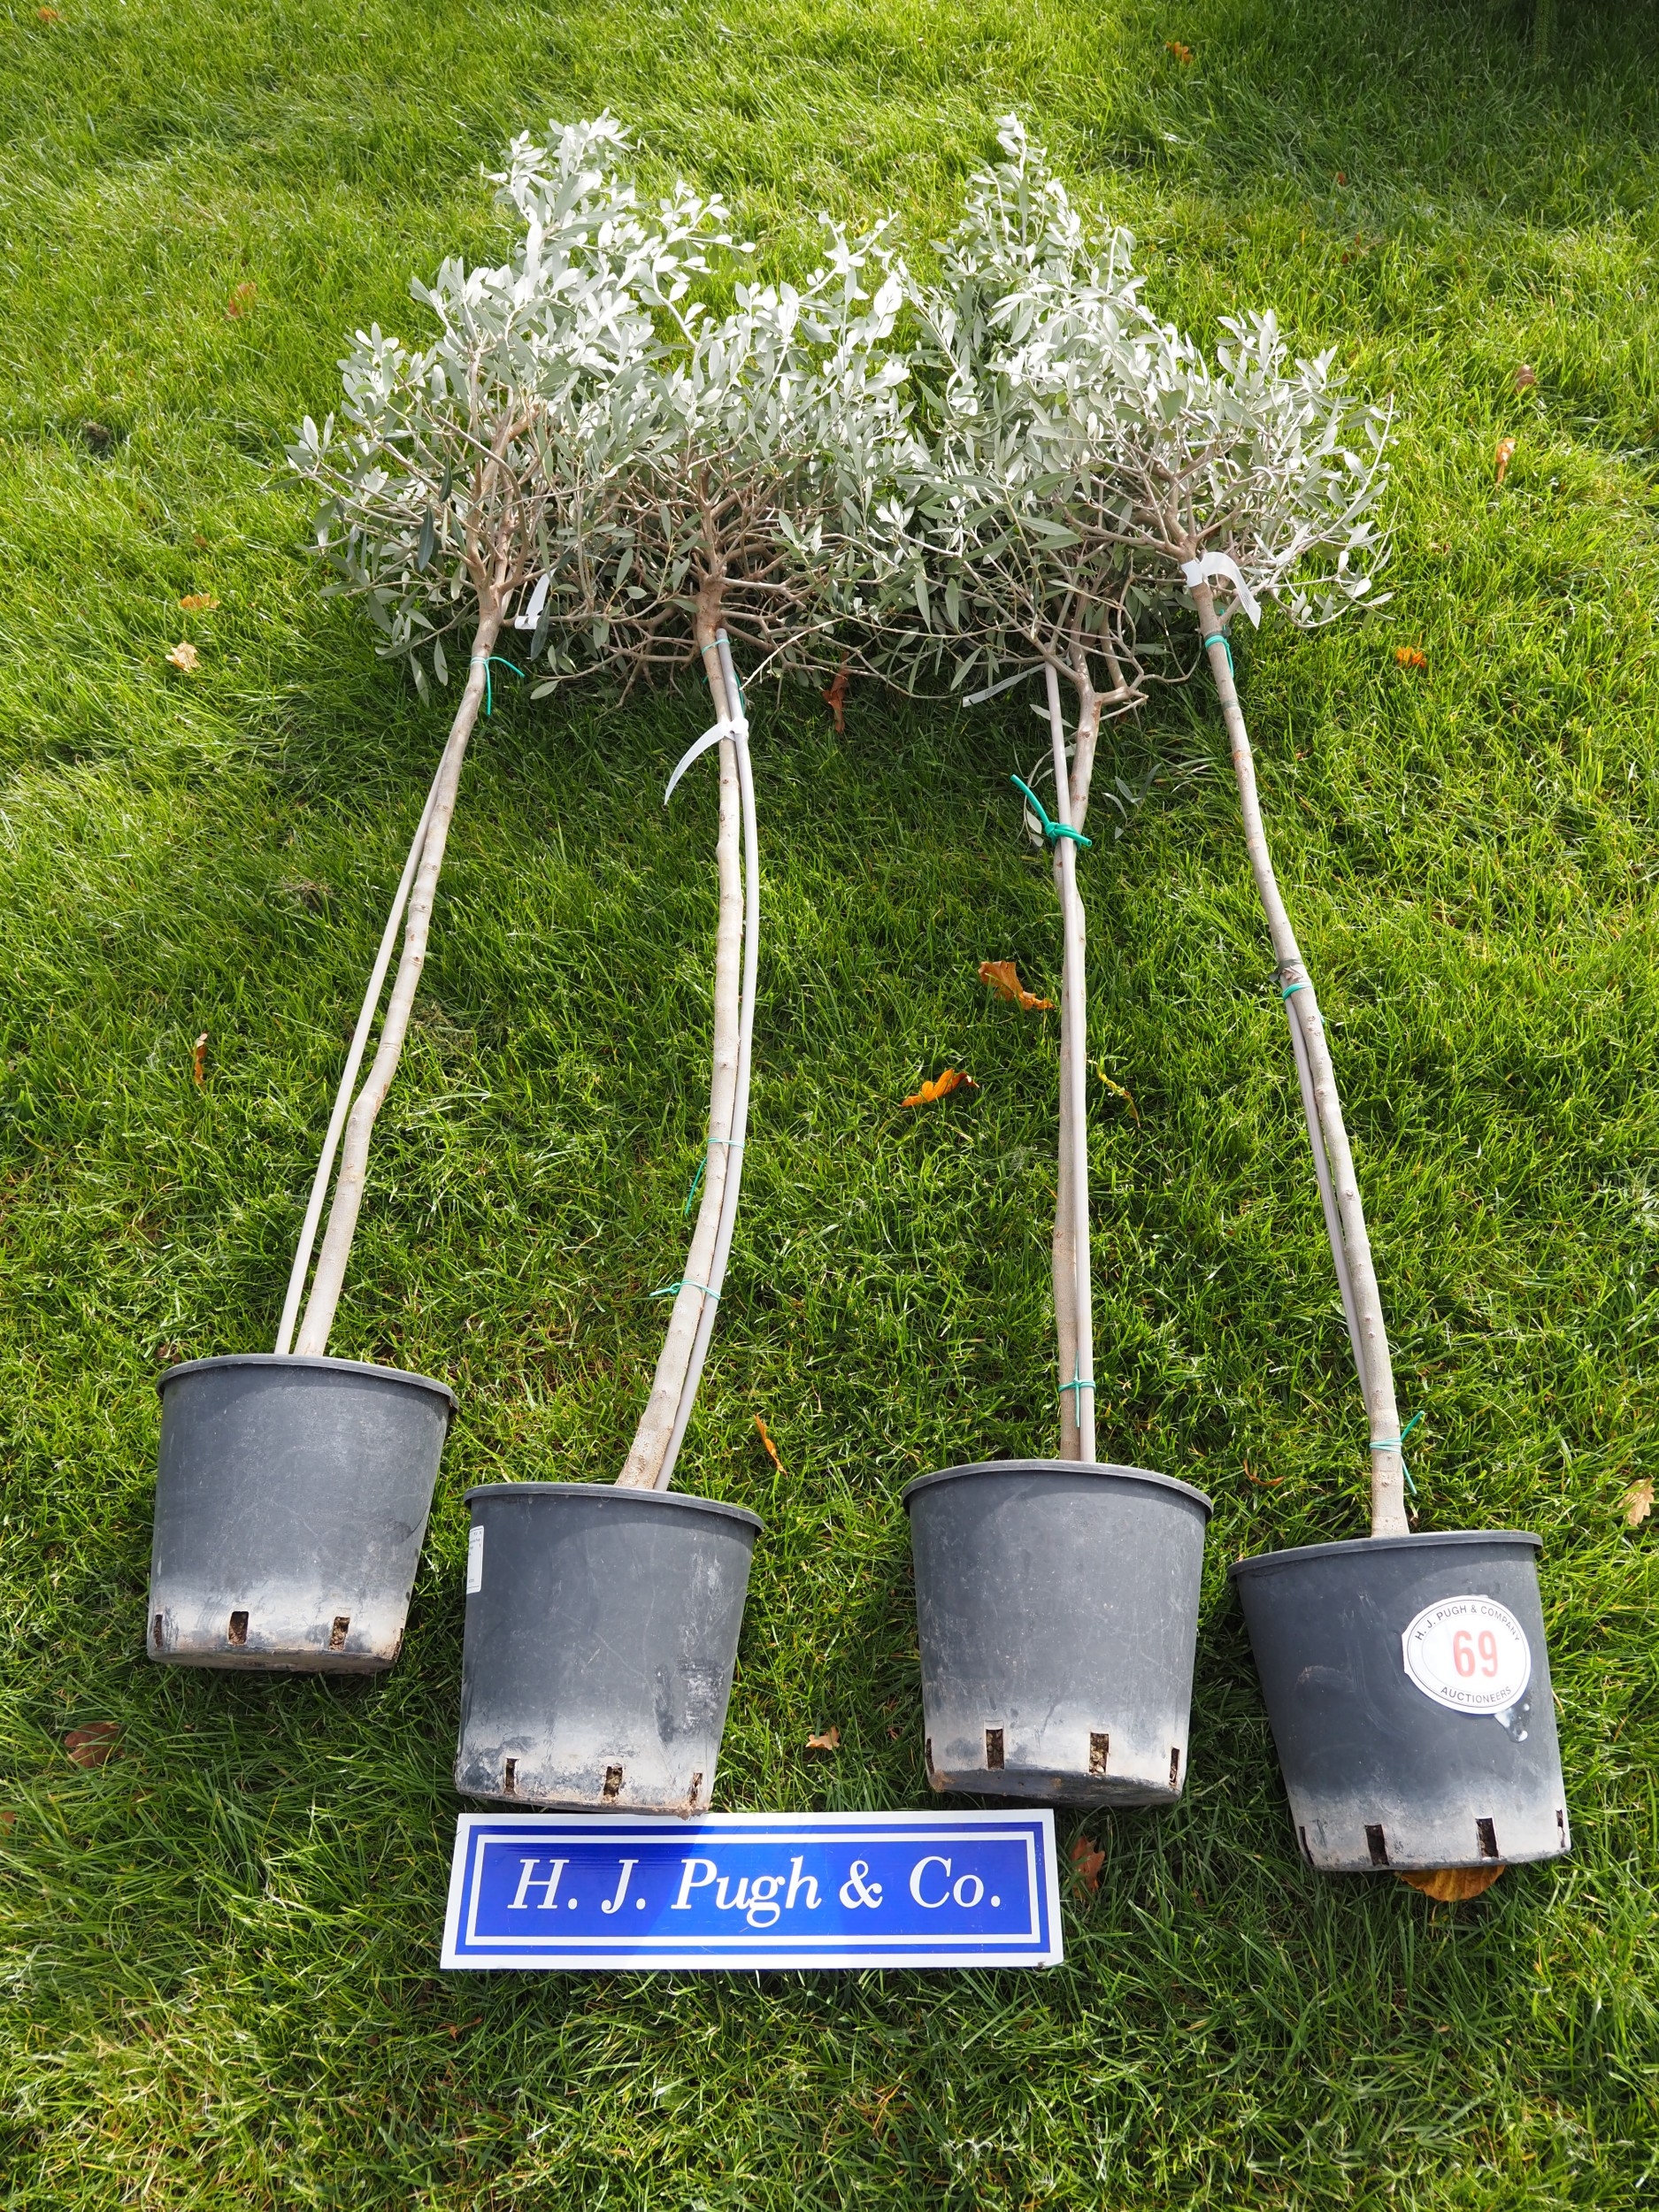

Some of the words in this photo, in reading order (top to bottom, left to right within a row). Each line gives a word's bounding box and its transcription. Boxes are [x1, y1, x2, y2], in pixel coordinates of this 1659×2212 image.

[1414, 1631, 1427, 1641] H.
[1426, 1619, 1436, 1629] J.
[1436, 1604, 1467, 1621] PUGH
[1471, 1604, 1478, 1614] &
[1480, 1605, 1520, 1641] COMPANY
[1453, 1630, 1499, 1678] 69
[1440, 1686, 1512, 1704] AUCTIONEERS
[507, 1858, 578, 1910] H.
[601, 1859, 646, 1915] J.
[670, 1855, 822, 1929] Pugh
[839, 1859, 883, 1909] &
[909, 1855, 1001, 1909] Co.
